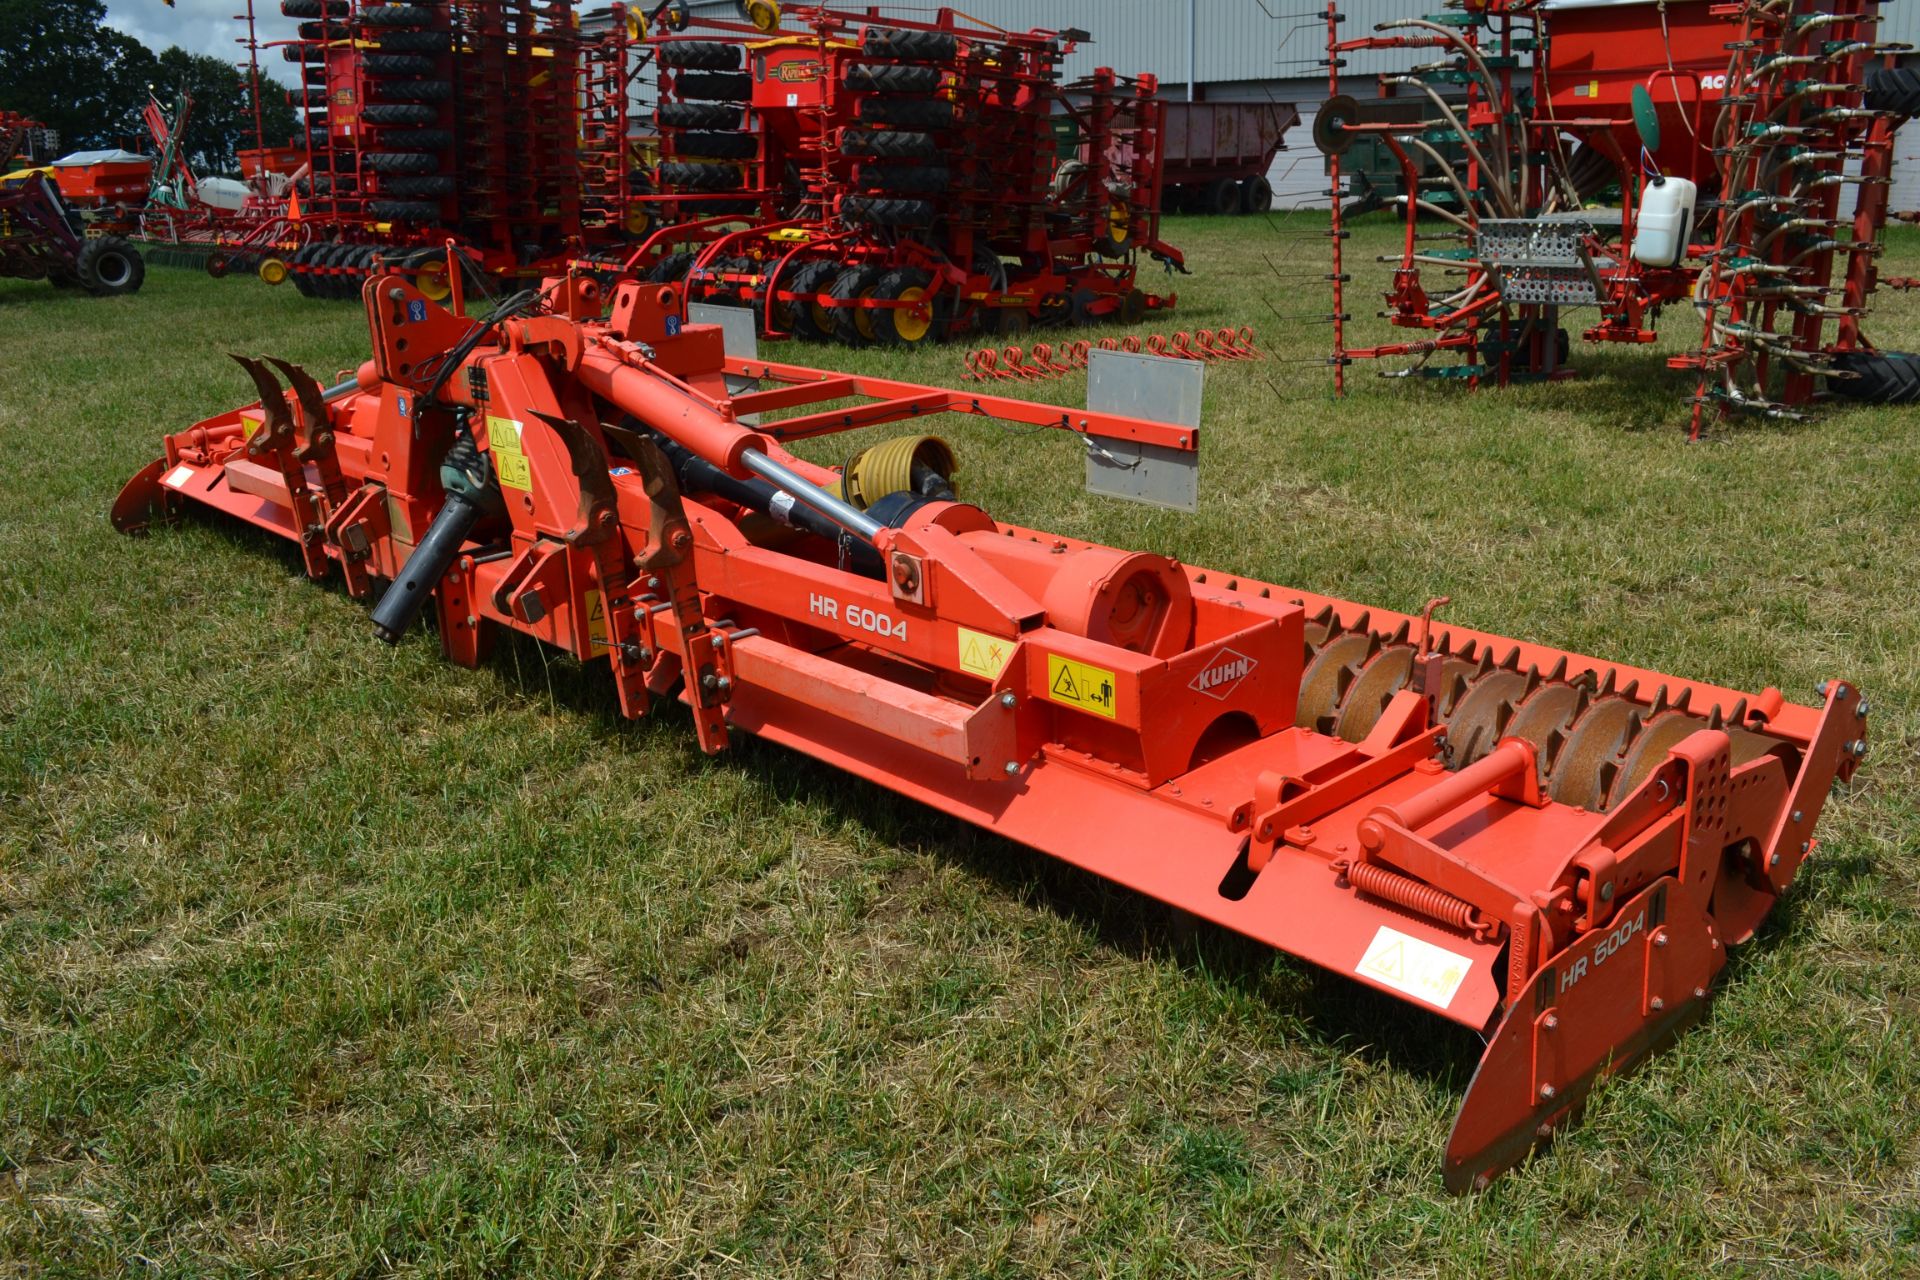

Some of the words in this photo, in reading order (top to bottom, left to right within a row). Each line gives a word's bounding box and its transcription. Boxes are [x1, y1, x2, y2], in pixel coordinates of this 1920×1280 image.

[809, 591, 839, 620] HR
[845, 604, 907, 642] 6004
[1199, 656, 1249, 691] KUHN
[1561, 956, 1588, 993] HR
[1594, 910, 1644, 966] 6004
